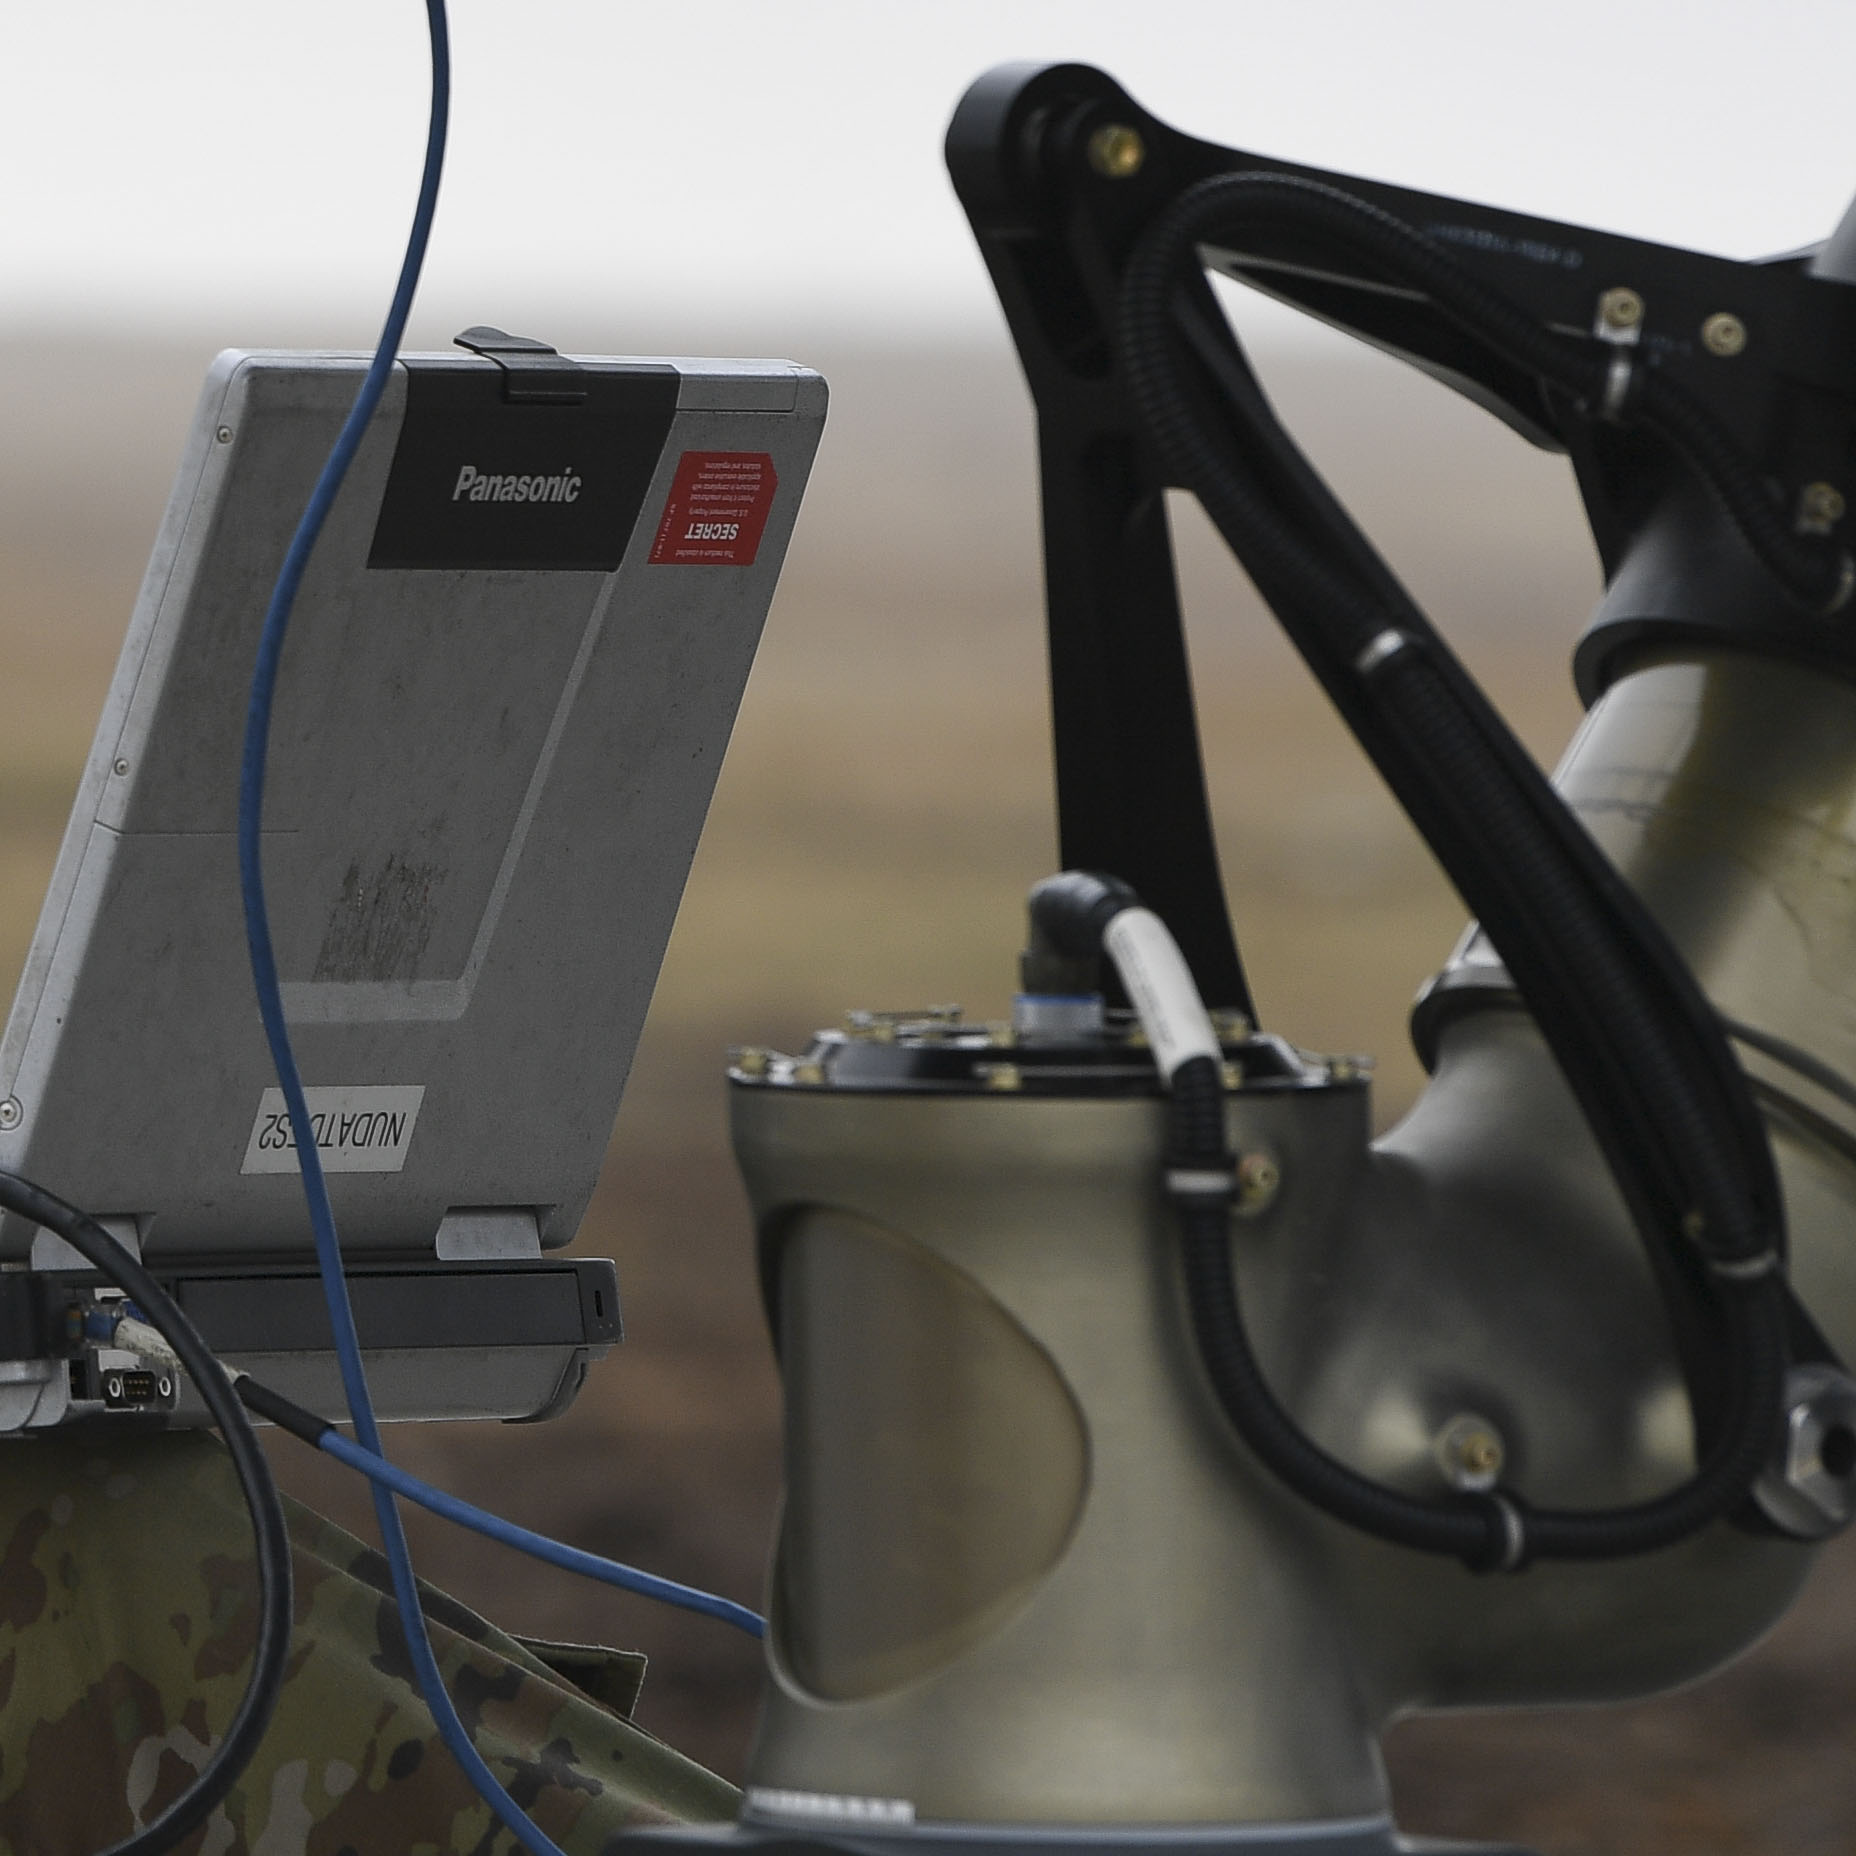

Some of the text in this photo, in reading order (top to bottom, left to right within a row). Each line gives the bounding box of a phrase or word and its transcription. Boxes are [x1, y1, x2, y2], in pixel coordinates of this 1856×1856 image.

[452, 465, 582, 502] Panasonic
[684, 523, 740, 540] SECRET
[259, 1112, 406, 1149] NUDATDS2
